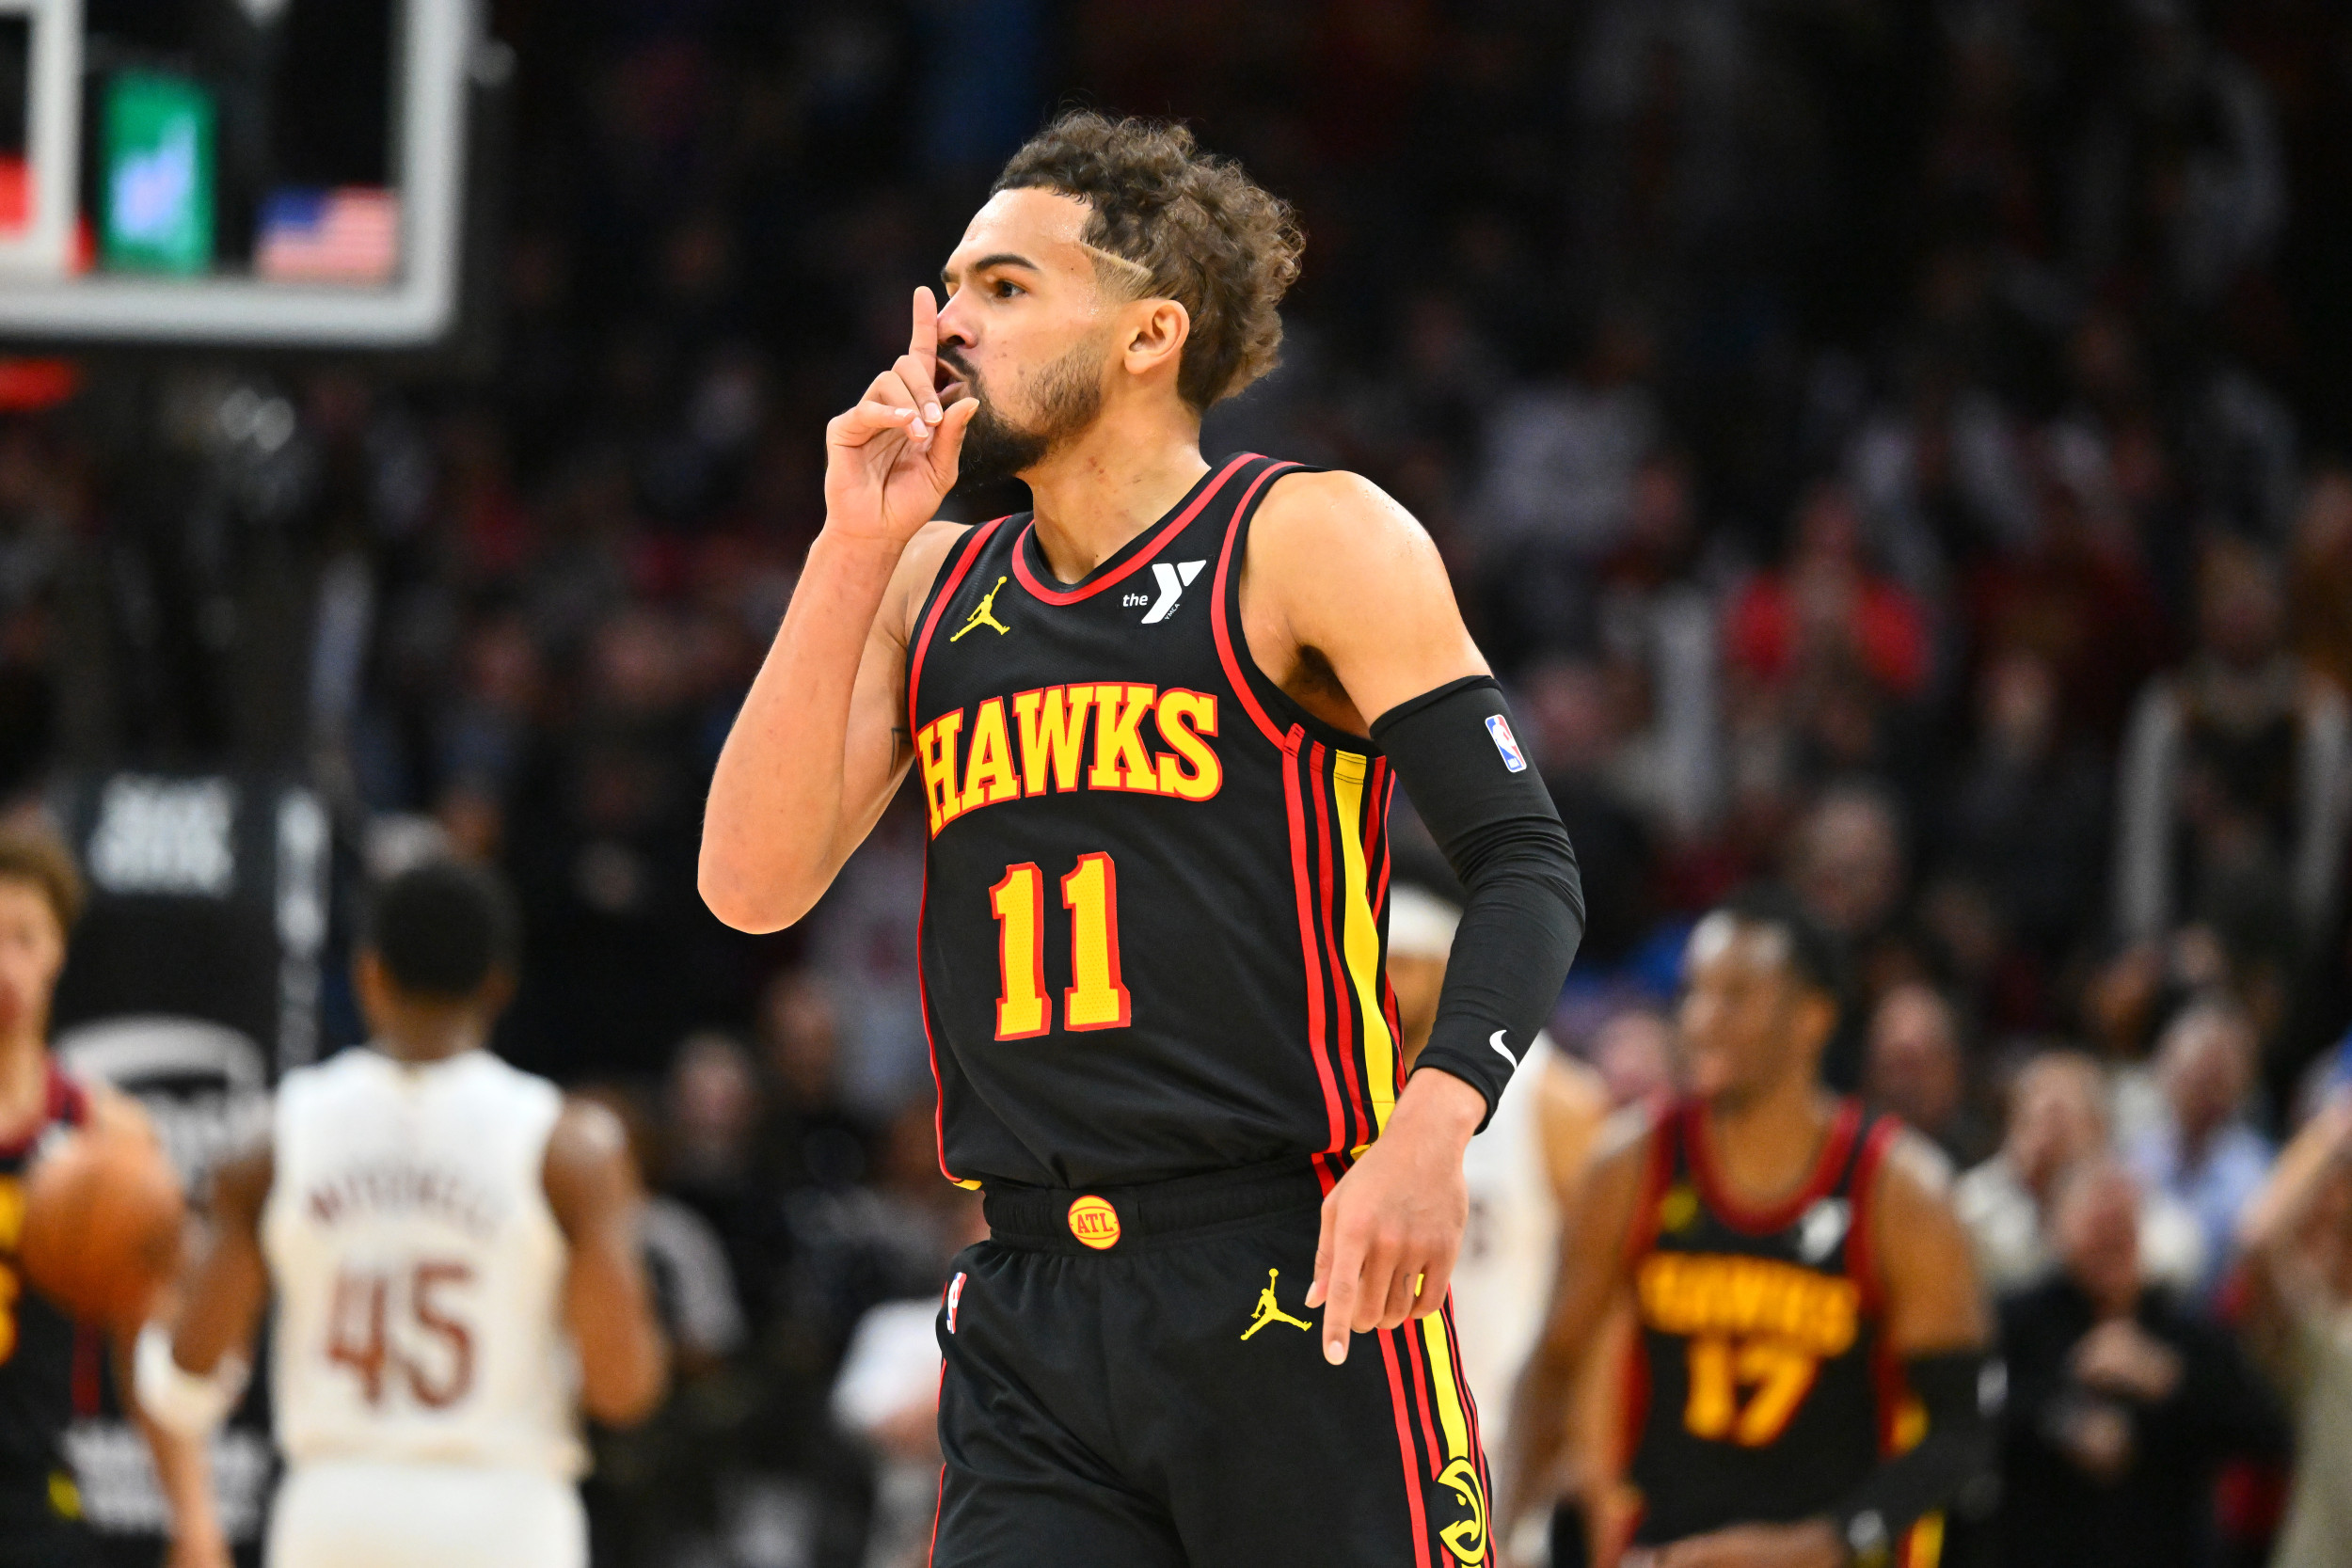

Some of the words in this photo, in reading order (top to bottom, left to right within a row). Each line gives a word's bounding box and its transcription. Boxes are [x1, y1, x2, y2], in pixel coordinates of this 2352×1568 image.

[1122, 593, 1148, 607] the
[1164, 603, 1181, 620] YMCA
[915, 682, 1223, 841] HAWKS
[988, 851, 1132, 1041] 11
[1077, 1212, 1115, 1233] ATL
[325, 1258, 480, 1411] 45
[1683, 1334, 1823, 1449] 17
